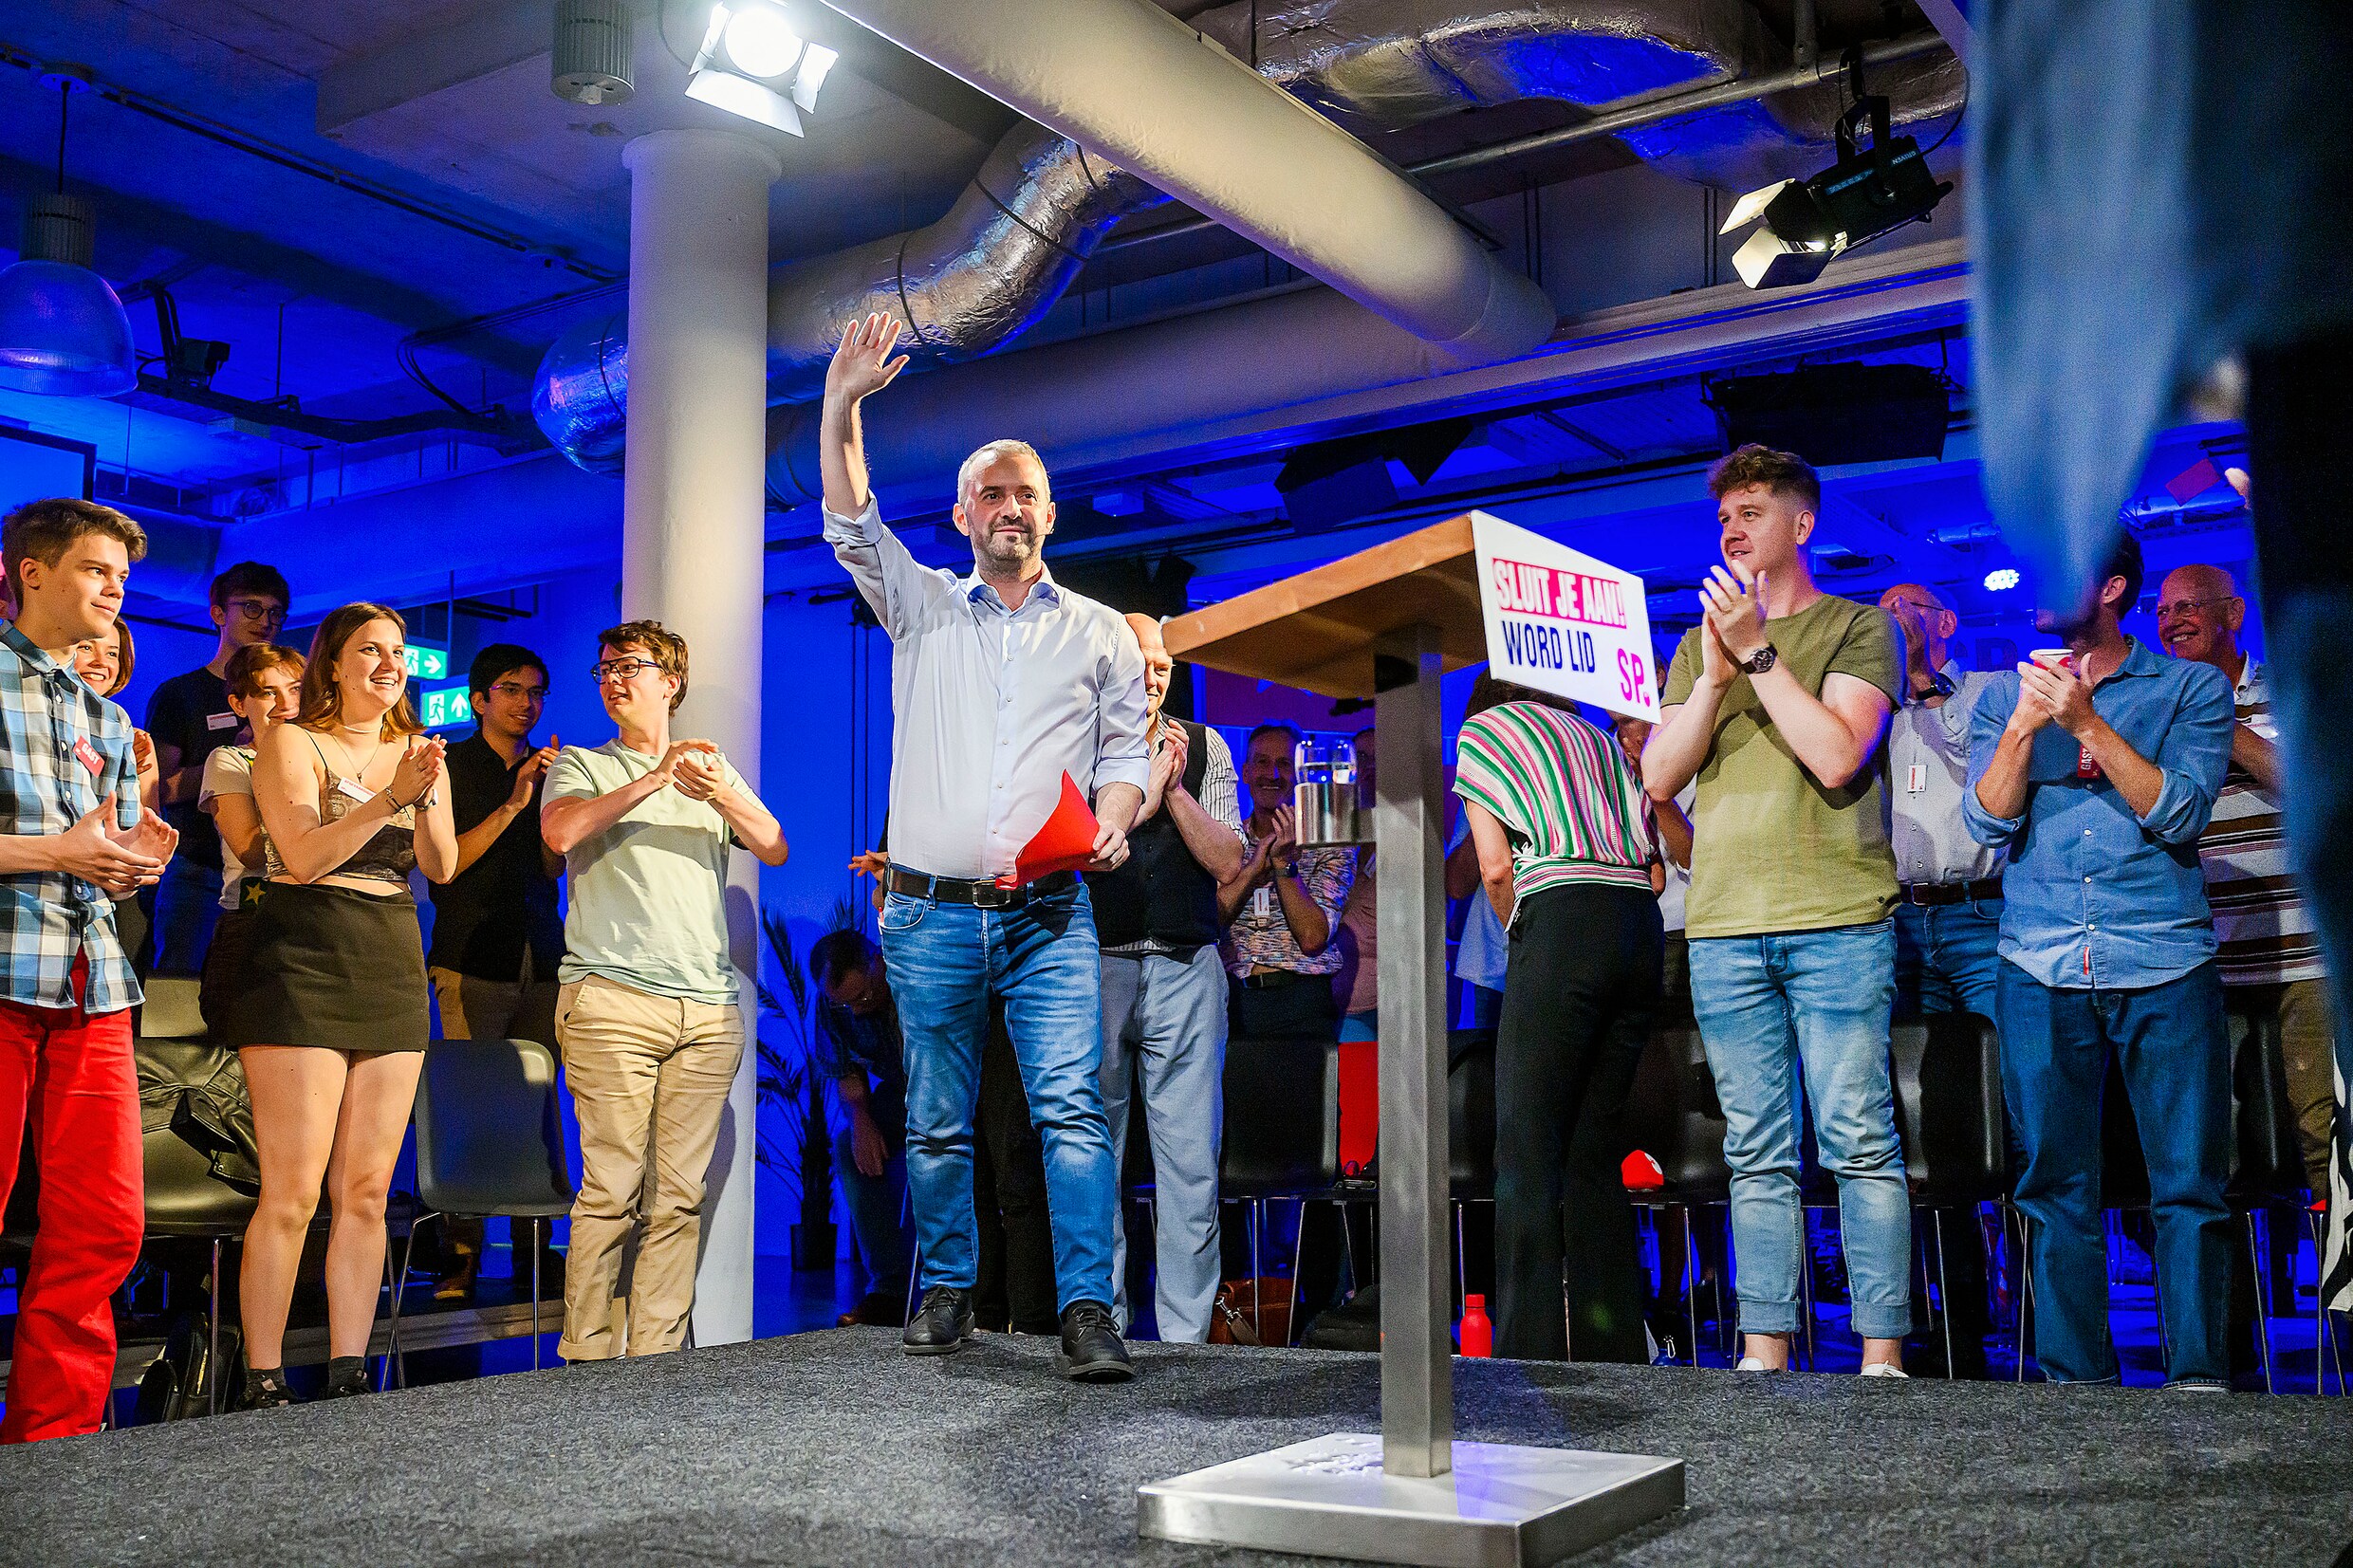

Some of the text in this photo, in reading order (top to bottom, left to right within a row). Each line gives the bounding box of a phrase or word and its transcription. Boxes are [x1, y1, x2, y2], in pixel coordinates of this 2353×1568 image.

[1492, 559, 1551, 616] SLUIT
[1555, 571, 1582, 619] JE
[1501, 620, 1596, 673] WORD LID
[1617, 648, 1651, 708] SP.
[81, 743, 101, 765] GAST
